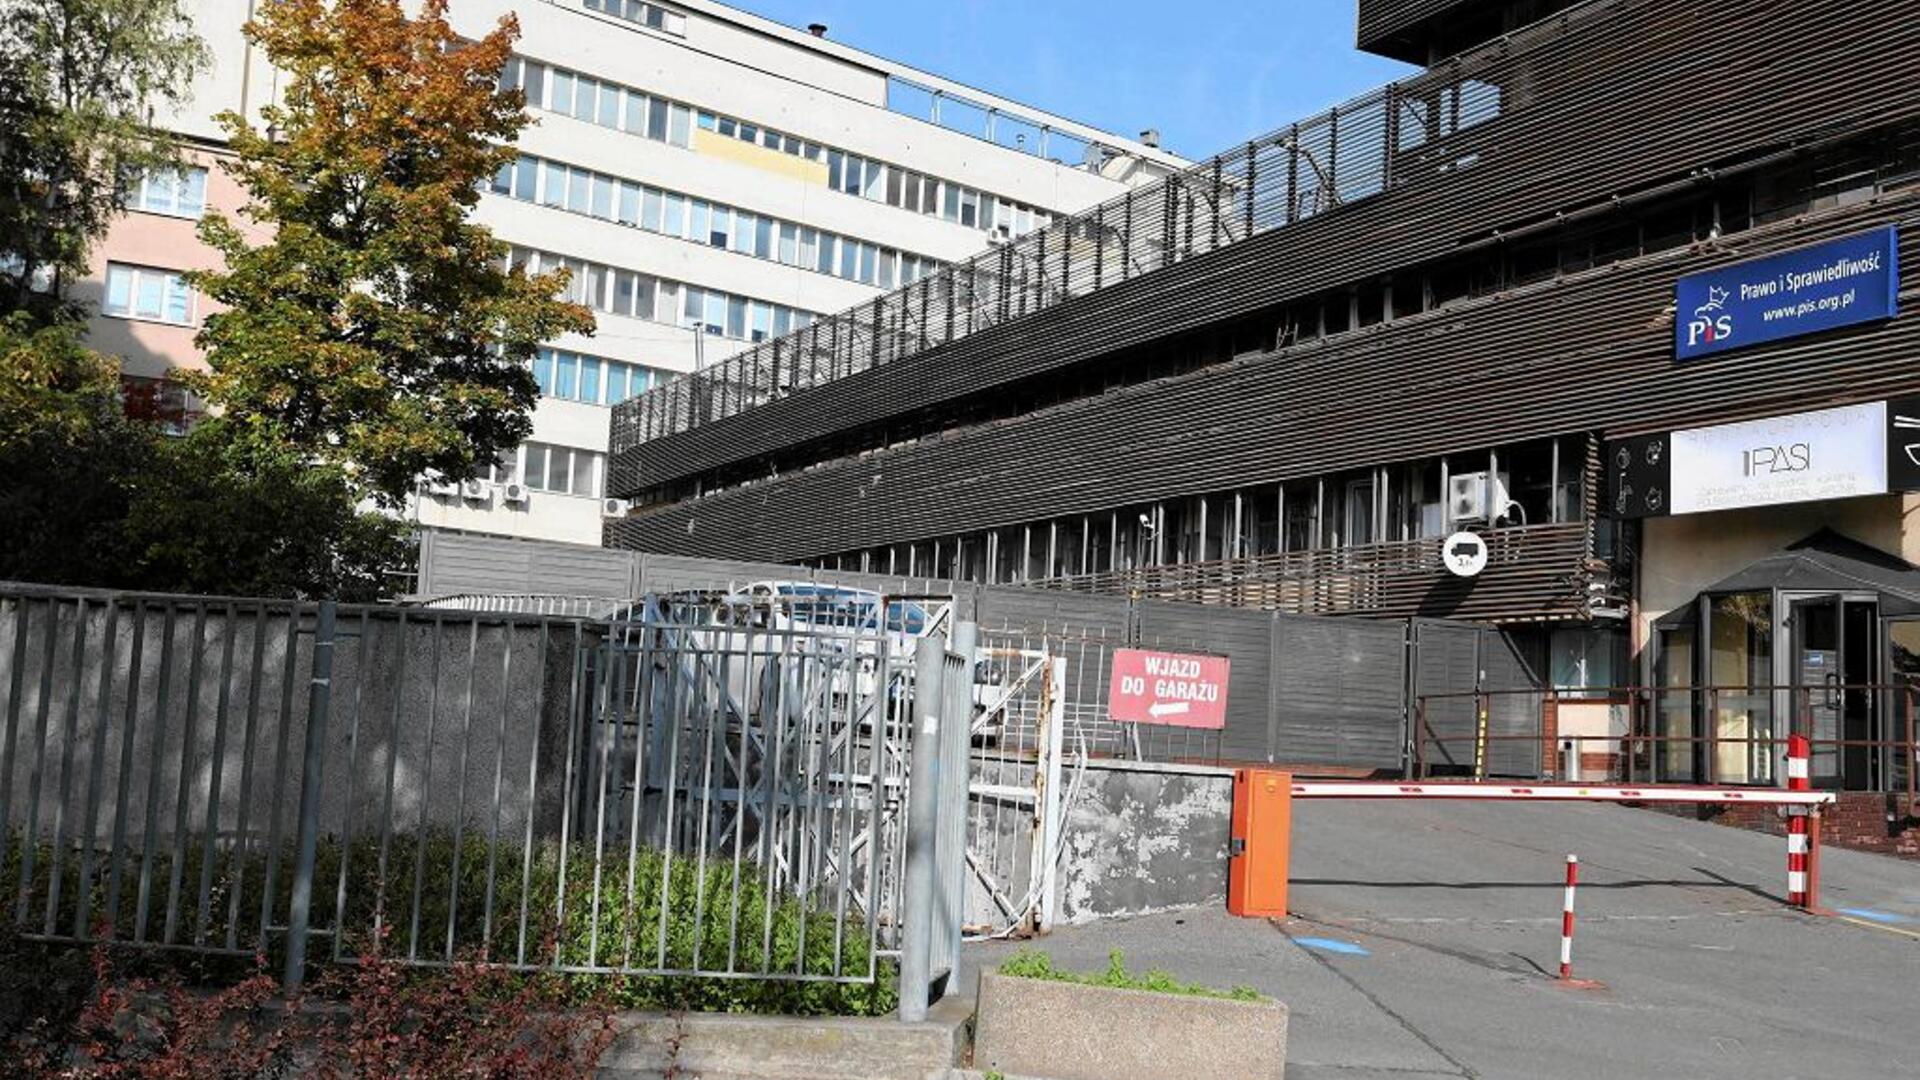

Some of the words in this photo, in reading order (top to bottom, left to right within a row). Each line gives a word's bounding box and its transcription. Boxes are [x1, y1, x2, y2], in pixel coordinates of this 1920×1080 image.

[1740, 282, 1777, 302] Prawo
[1778, 273, 1785, 292] i
[1786, 250, 1880, 293] Sprawiedliwość
[1763, 288, 1856, 322] www.pis.org.pl
[1145, 656, 1201, 679] WJAZD
[1120, 676, 1145, 696] DO
[1155, 680, 1218, 702] GARAŻU
